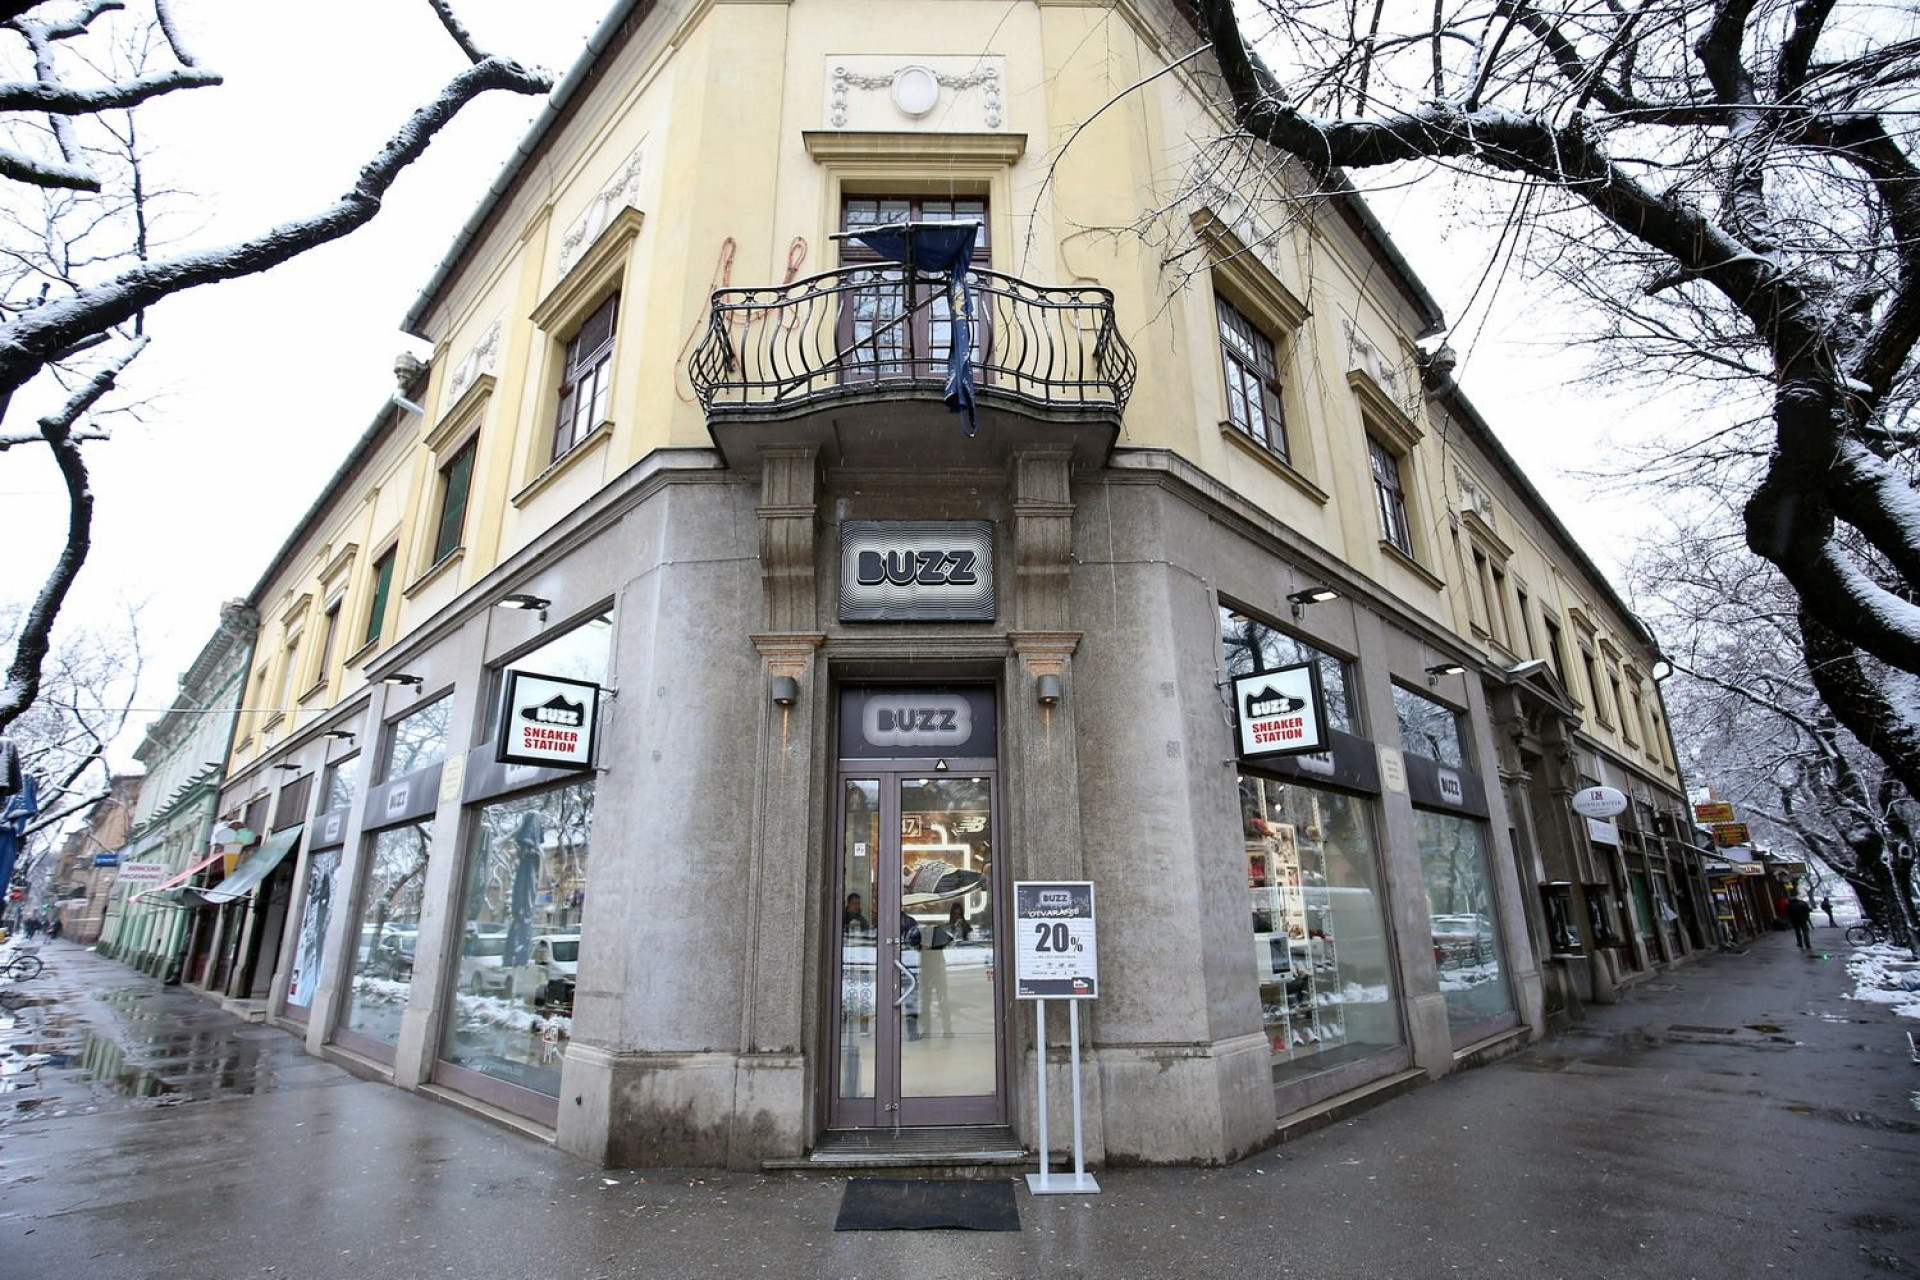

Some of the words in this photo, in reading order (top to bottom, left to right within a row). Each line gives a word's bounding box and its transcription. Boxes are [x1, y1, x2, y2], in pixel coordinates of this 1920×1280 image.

[857, 550, 978, 586] BUZZ
[536, 707, 579, 725] BUZZ
[1251, 698, 1291, 717] BUZZ
[877, 708, 957, 732] BUZZ
[1252, 717, 1303, 733] SNEAKER
[523, 727, 578, 742] SNEAKER
[1255, 728, 1303, 744] STATION
[524, 738, 575, 753] STATION
[1043, 894, 1068, 902] BUZZ
[1035, 922, 1083, 952] 20%
